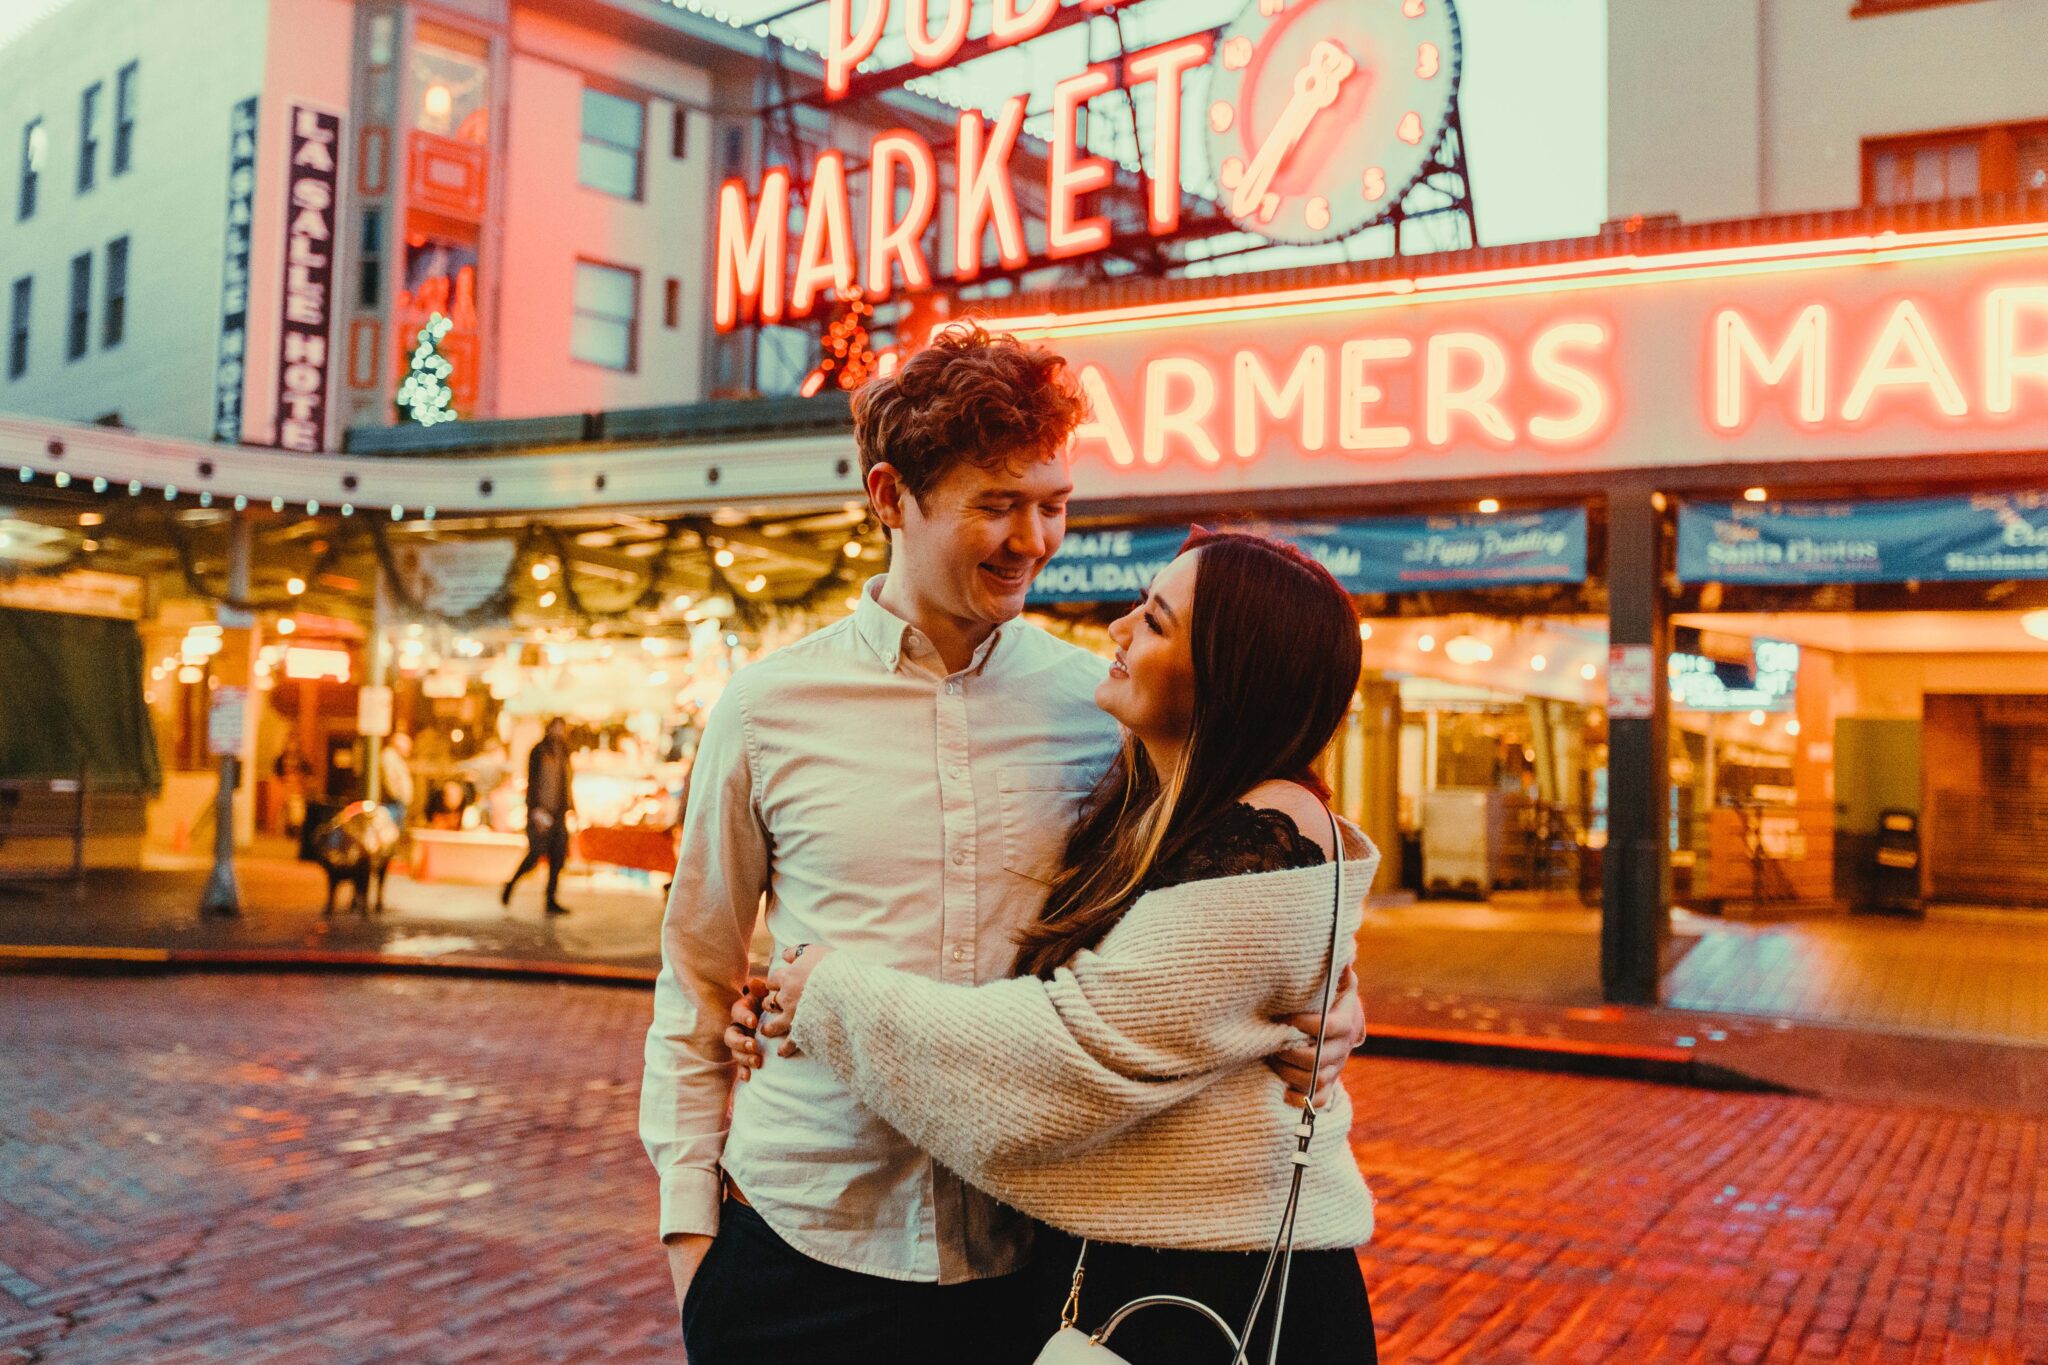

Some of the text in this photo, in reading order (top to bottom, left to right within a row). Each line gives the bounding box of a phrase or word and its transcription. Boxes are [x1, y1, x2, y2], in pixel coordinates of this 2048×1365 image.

[281, 110, 336, 451] LA SALLE HOTE
[714, 33, 1212, 333] MARKET
[1068, 322, 1605, 466] ARMERS
